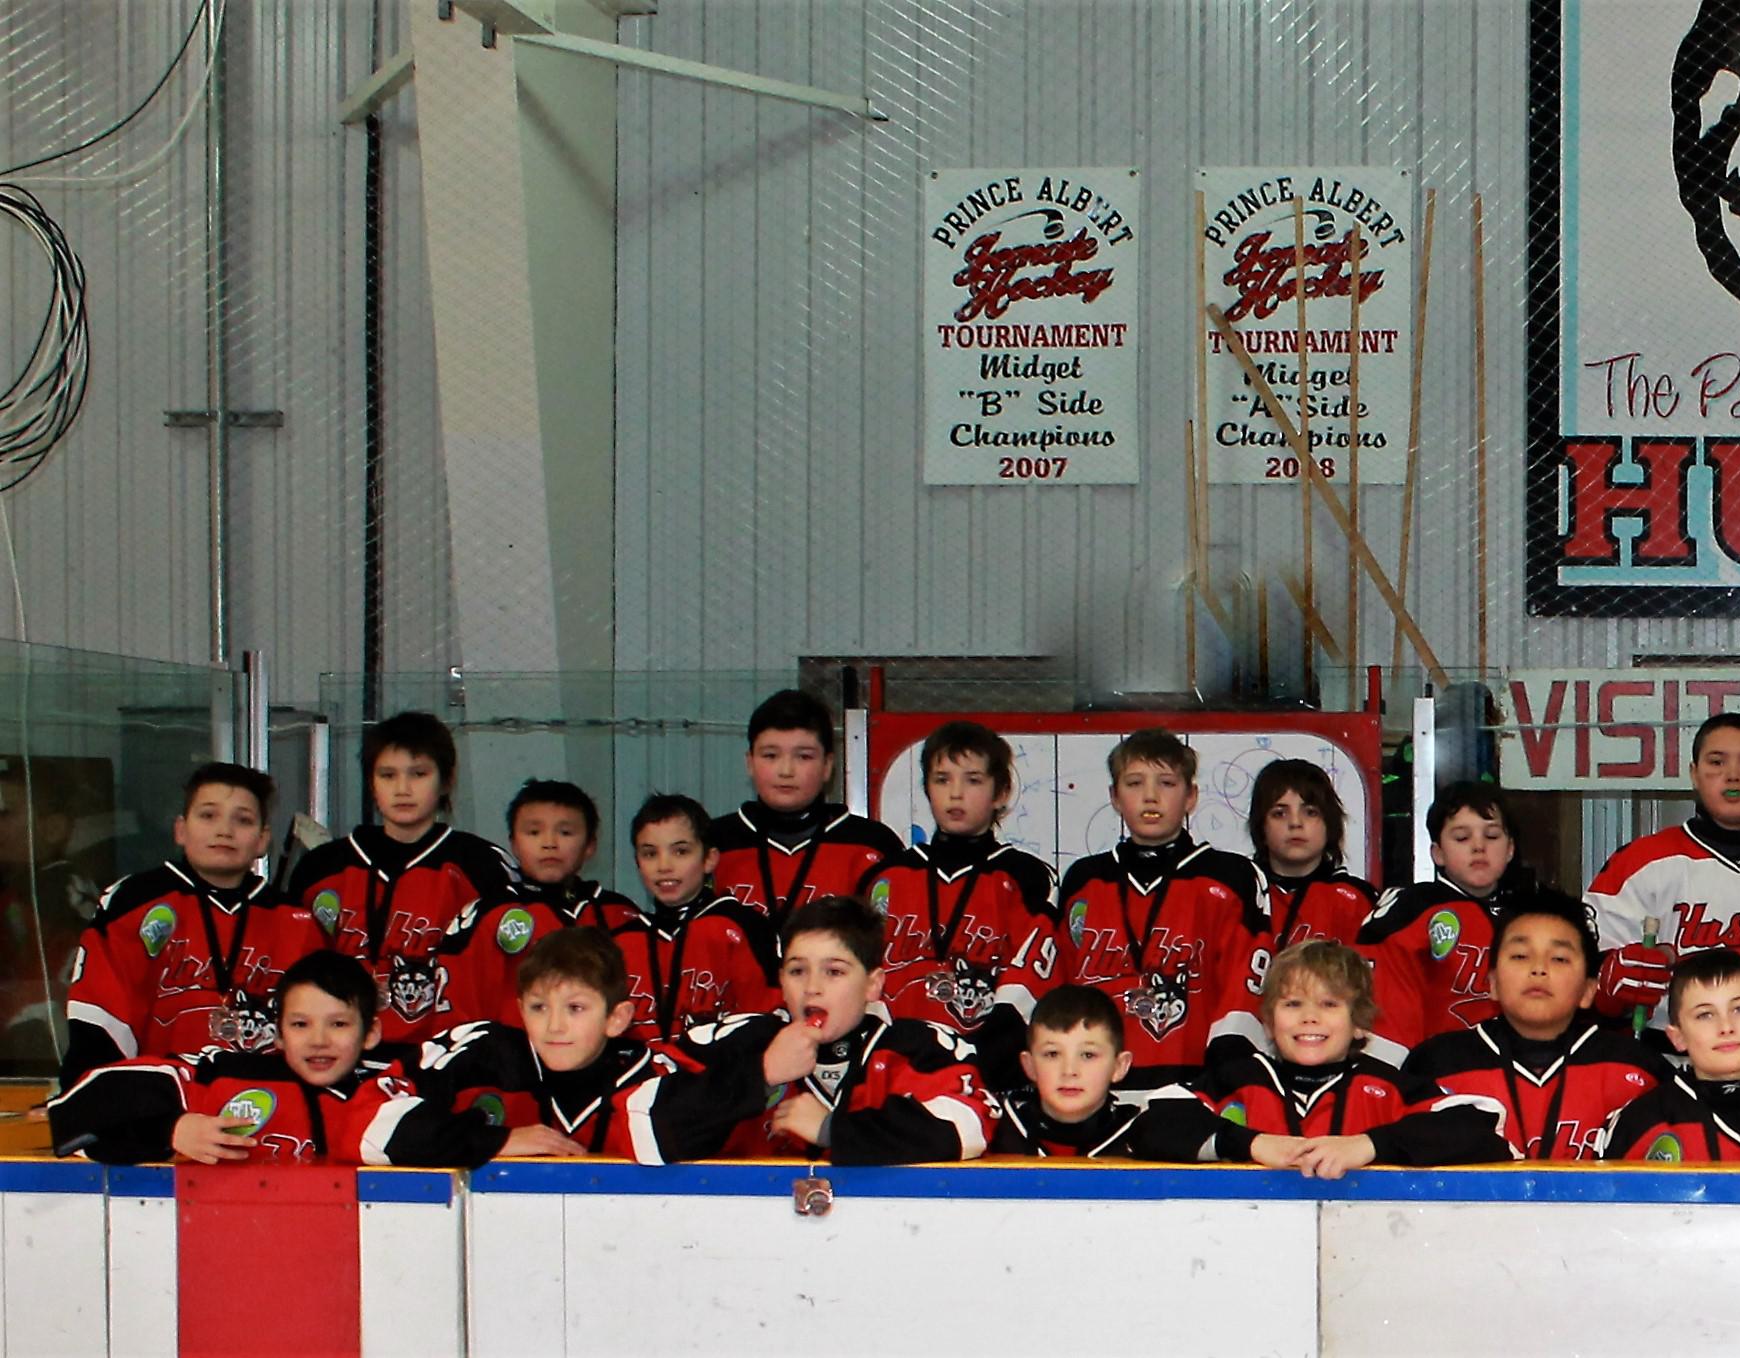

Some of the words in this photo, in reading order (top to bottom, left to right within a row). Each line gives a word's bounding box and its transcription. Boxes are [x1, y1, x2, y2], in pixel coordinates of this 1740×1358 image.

[932, 177, 1023, 249] PRINCE
[1036, 176, 1134, 246] ALBERT
[1204, 177, 1295, 249] PRINCE
[1308, 177, 1406, 249] ALBERT
[938, 323, 1127, 348] TOURNAMENT
[979, 353, 1084, 385] Midget
[1586, 353, 1679, 419] The
[1037, 390, 1104, 415] Side
[950, 423, 1116, 452] Champions
[998, 457, 1068, 478] 2007
[1265, 457, 1335, 478] 208
[1010, 926, 1058, 980] 19
